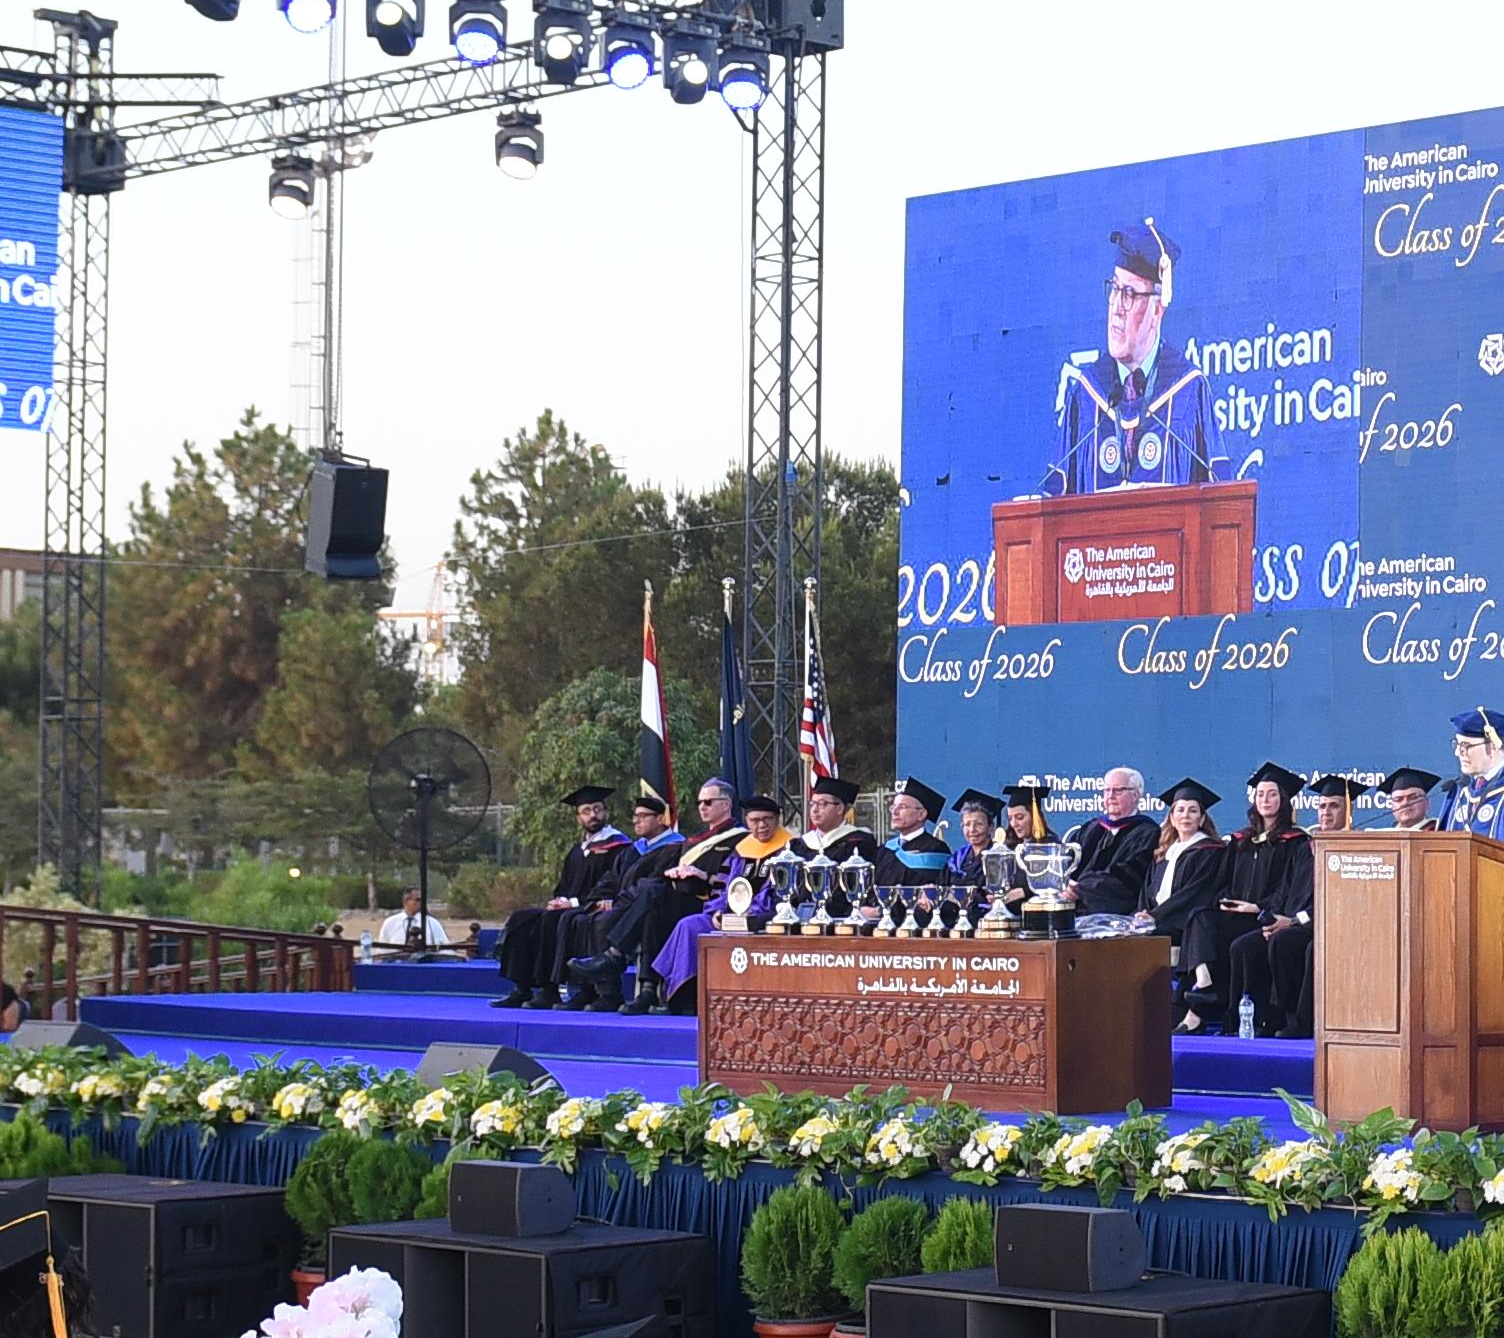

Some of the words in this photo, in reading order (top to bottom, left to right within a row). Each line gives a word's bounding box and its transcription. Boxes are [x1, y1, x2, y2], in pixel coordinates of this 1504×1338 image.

[1390, 143, 1468, 170] American
[1438, 165, 1454, 185] in
[1455, 159, 1499, 182] Cairo
[1374, 192, 1453, 257] Class
[1274, 390, 1304, 426] in
[1085, 547, 1105, 563] The
[1106, 543, 1156, 562] American
[1084, 563, 1135, 582] University
[1147, 560, 1175, 578] Cairo
[1118, 615, 1187, 674] Class
[1189, 612, 1236, 690] of
[1221, 627, 1298, 670] 2026
[1362, 601, 1441, 665] Class
[1443, 599, 1496, 681] of
[898, 627, 963, 683] Class
[963, 624, 1006, 698] of
[992, 638, 1062, 680] 2026
[750, 952, 779, 967] THE
[780, 953, 855, 968] AMERICAN
[858, 954, 948, 970] UNIVERSITY
[951, 956, 967, 971] IN
[970, 956, 1020, 972] CAIRO
